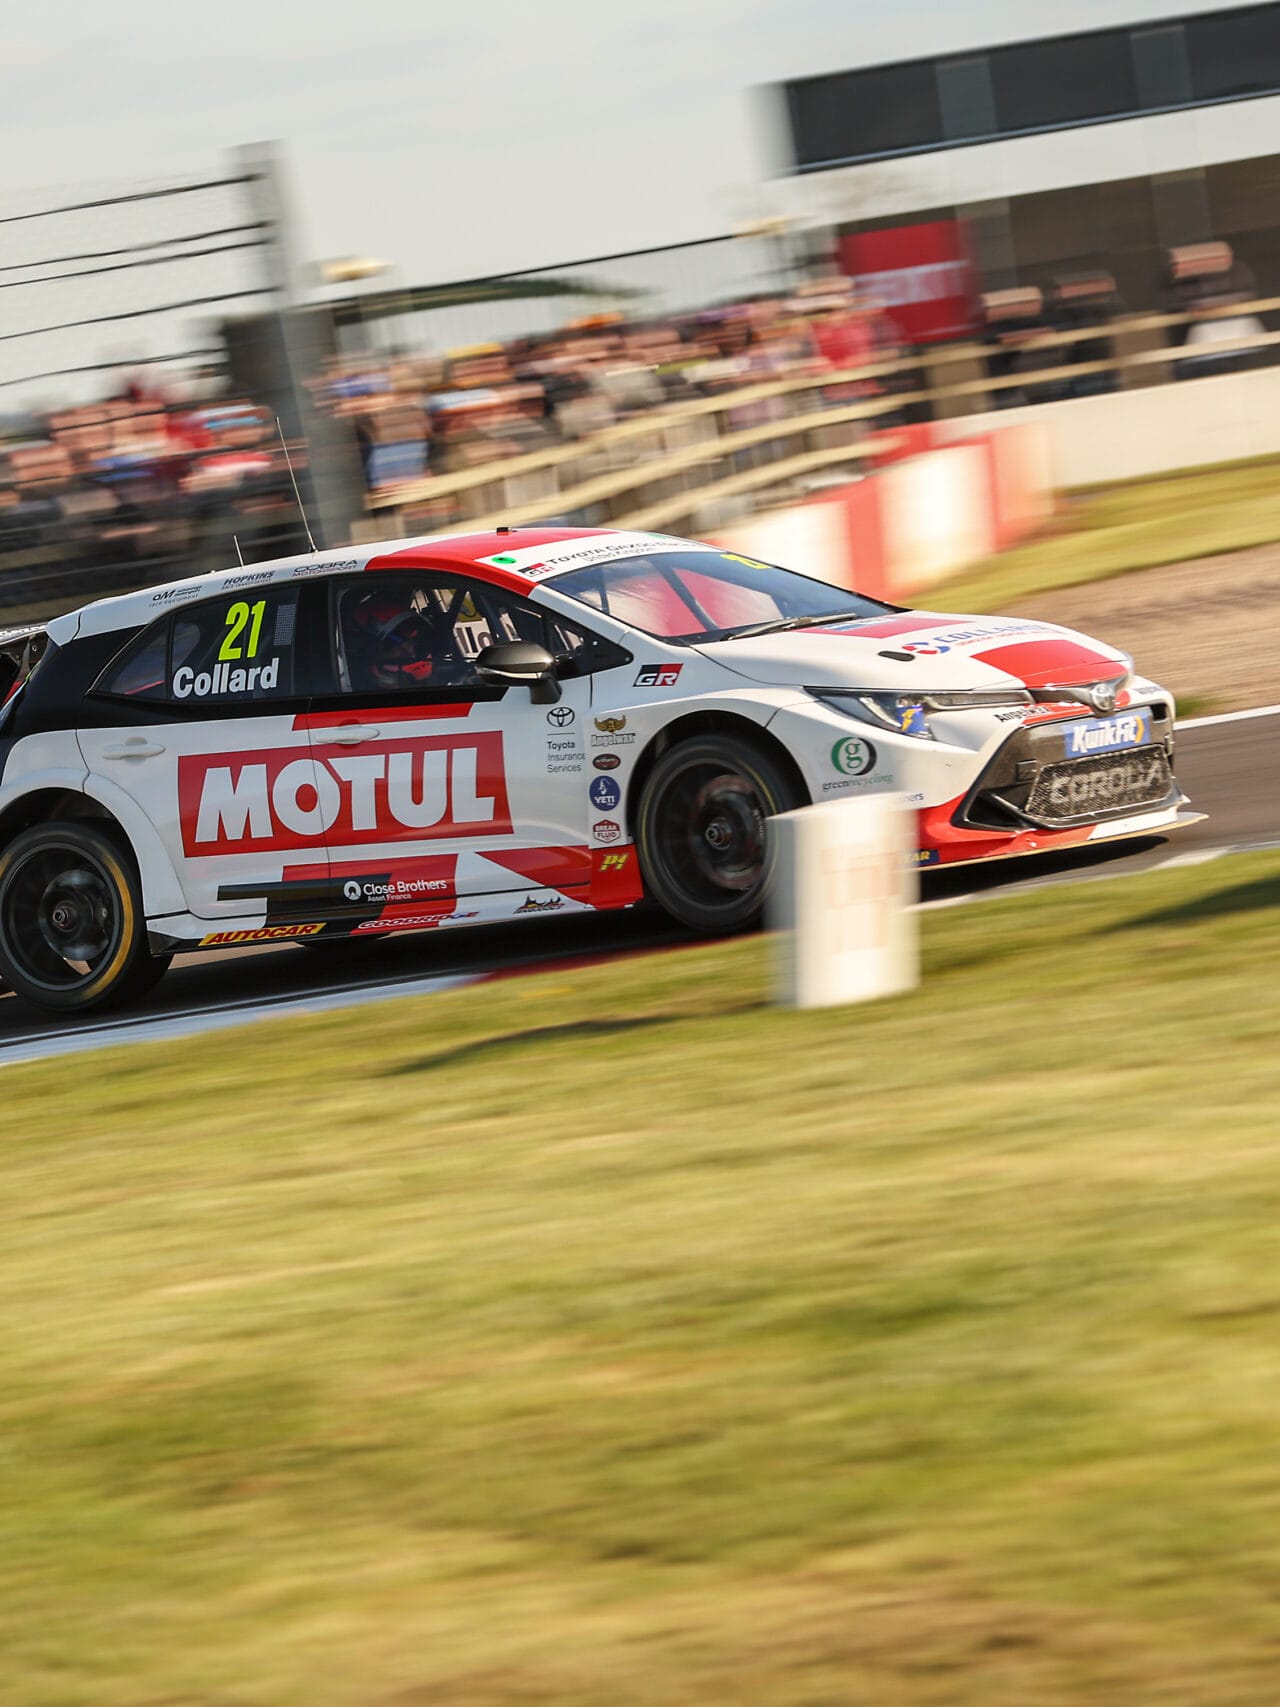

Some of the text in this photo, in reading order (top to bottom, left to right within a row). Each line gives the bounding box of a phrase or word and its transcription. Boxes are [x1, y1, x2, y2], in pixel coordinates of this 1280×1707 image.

[294, 559, 358, 573] COBRA
[223, 570, 275, 586] HOPKINS
[218, 601, 266, 661] 21
[172, 657, 279, 698] Collard
[634, 672, 678, 686] GR
[547, 741, 576, 751] Toyota
[547, 752, 586, 762] Insurance
[547, 763, 582, 773] Services
[195, 747, 495, 843] MOTUL
[594, 795, 615, 804] YETI
[363, 880, 448, 896] Close Brothers
[358, 911, 480, 929] GOODRIDGE
[205, 924, 319, 945] AUTOCAR
